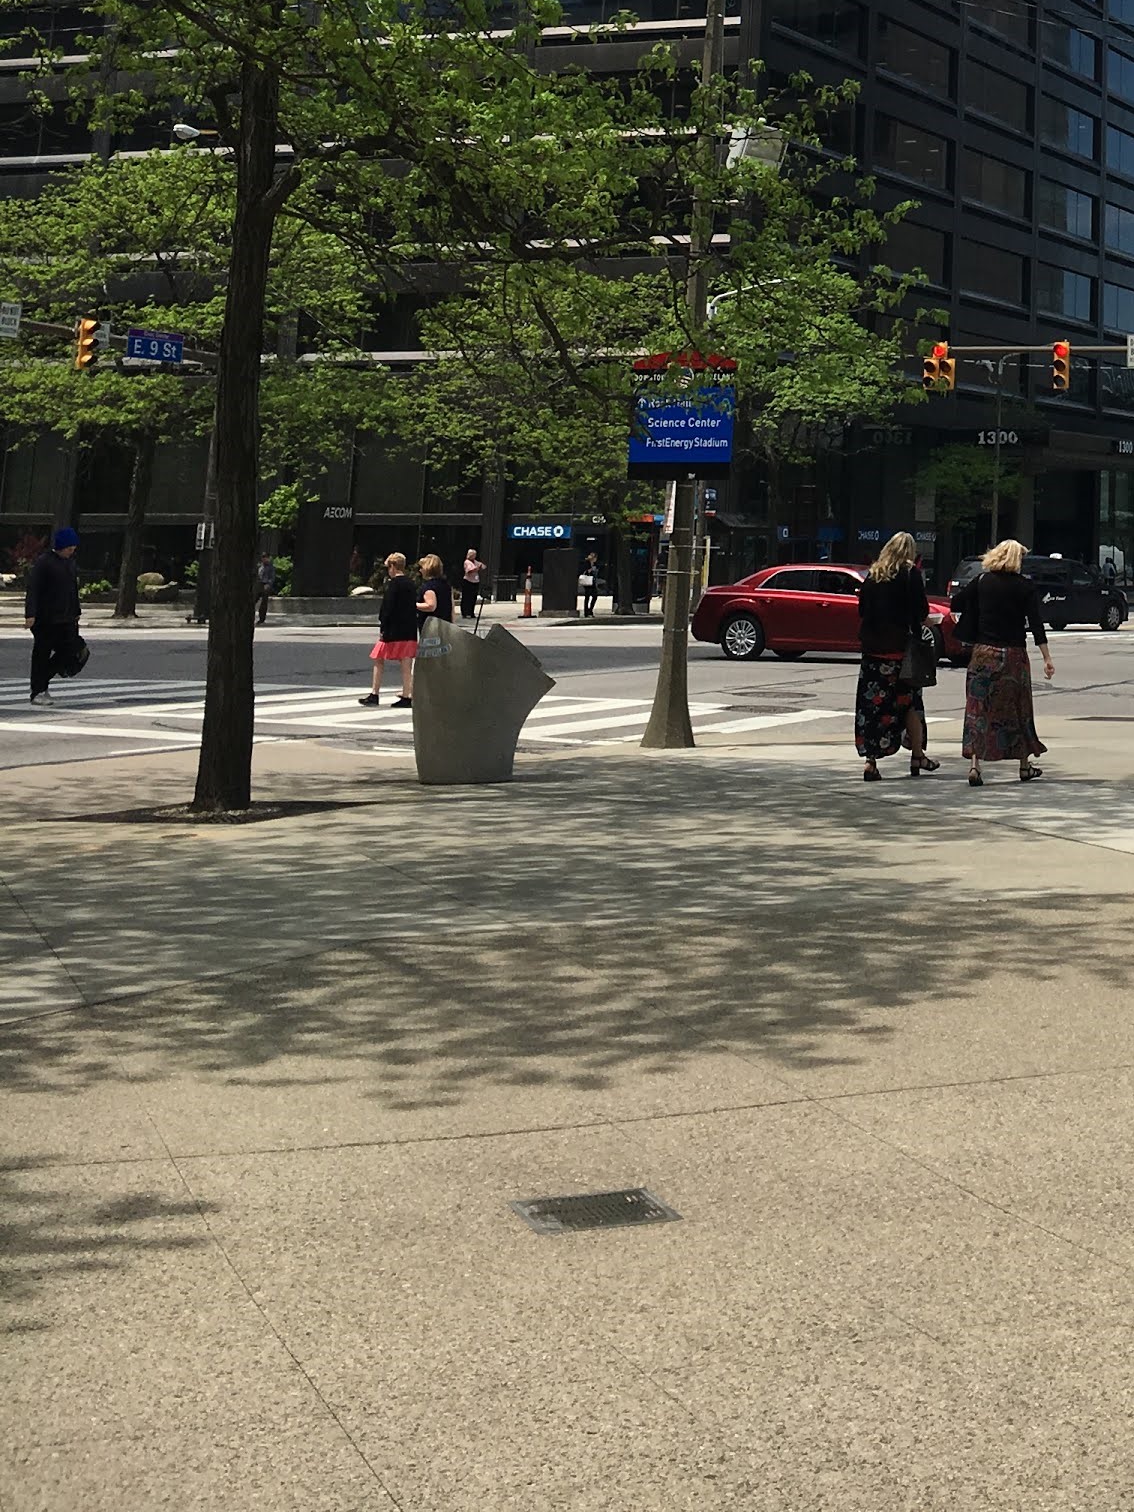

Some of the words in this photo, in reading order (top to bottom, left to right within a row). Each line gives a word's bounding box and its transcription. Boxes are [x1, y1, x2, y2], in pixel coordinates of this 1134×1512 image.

[134, 339, 144, 355] E.
[150, 341, 158, 356] 9
[162, 342, 177, 358] St
[647, 417, 686, 428] Science
[688, 417, 721, 428] Center
[694, 437, 728, 448] Stadium
[977, 431, 1019, 444] 1300
[1118, 441, 1133, 453] 1300
[323, 507, 352, 518] AECOM
[513, 526, 552, 537] CHASE
